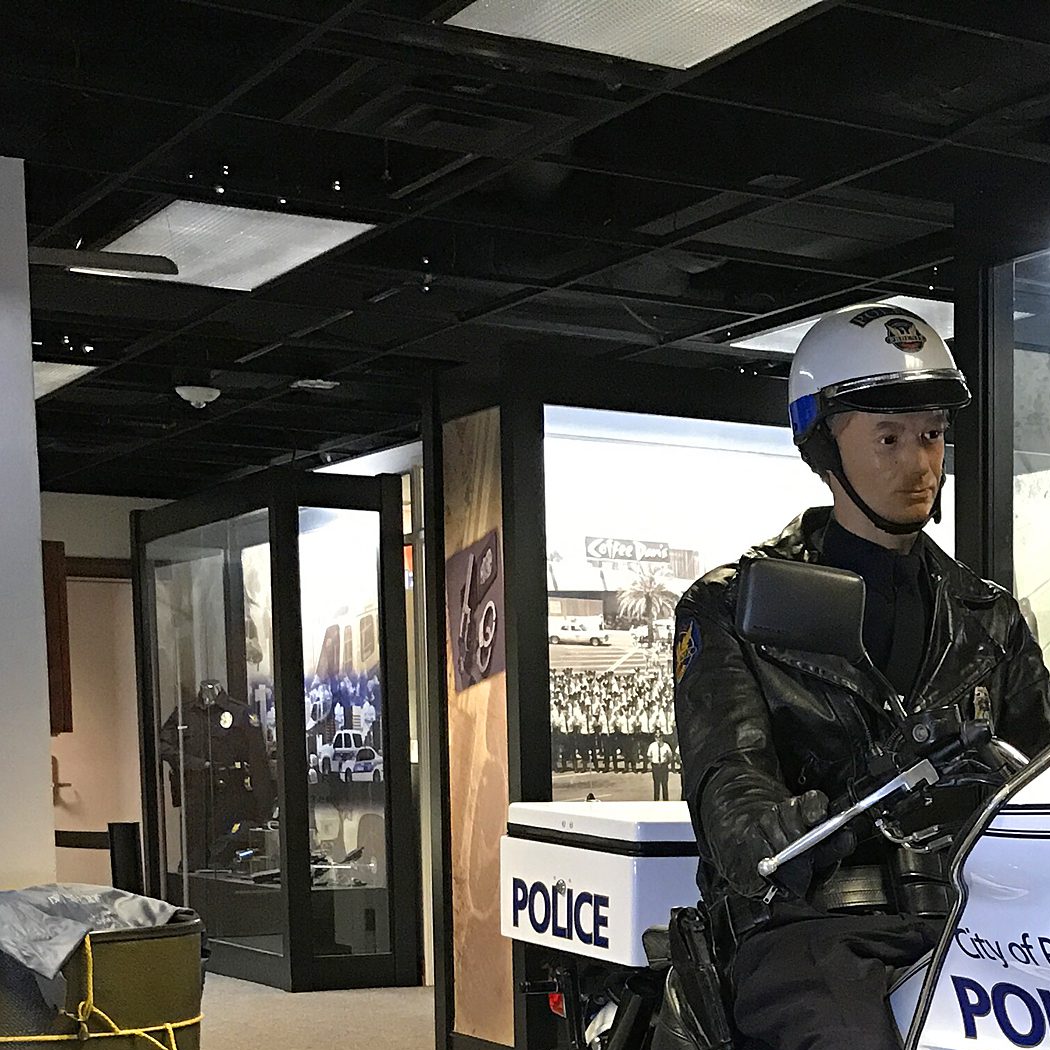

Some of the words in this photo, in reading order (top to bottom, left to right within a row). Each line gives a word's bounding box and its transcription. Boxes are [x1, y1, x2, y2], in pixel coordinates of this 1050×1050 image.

[587, 538, 633, 559] Coffee
[512, 877, 610, 949] POLICE
[955, 927, 1009, 968] City
[1008, 932, 1040, 966] of
